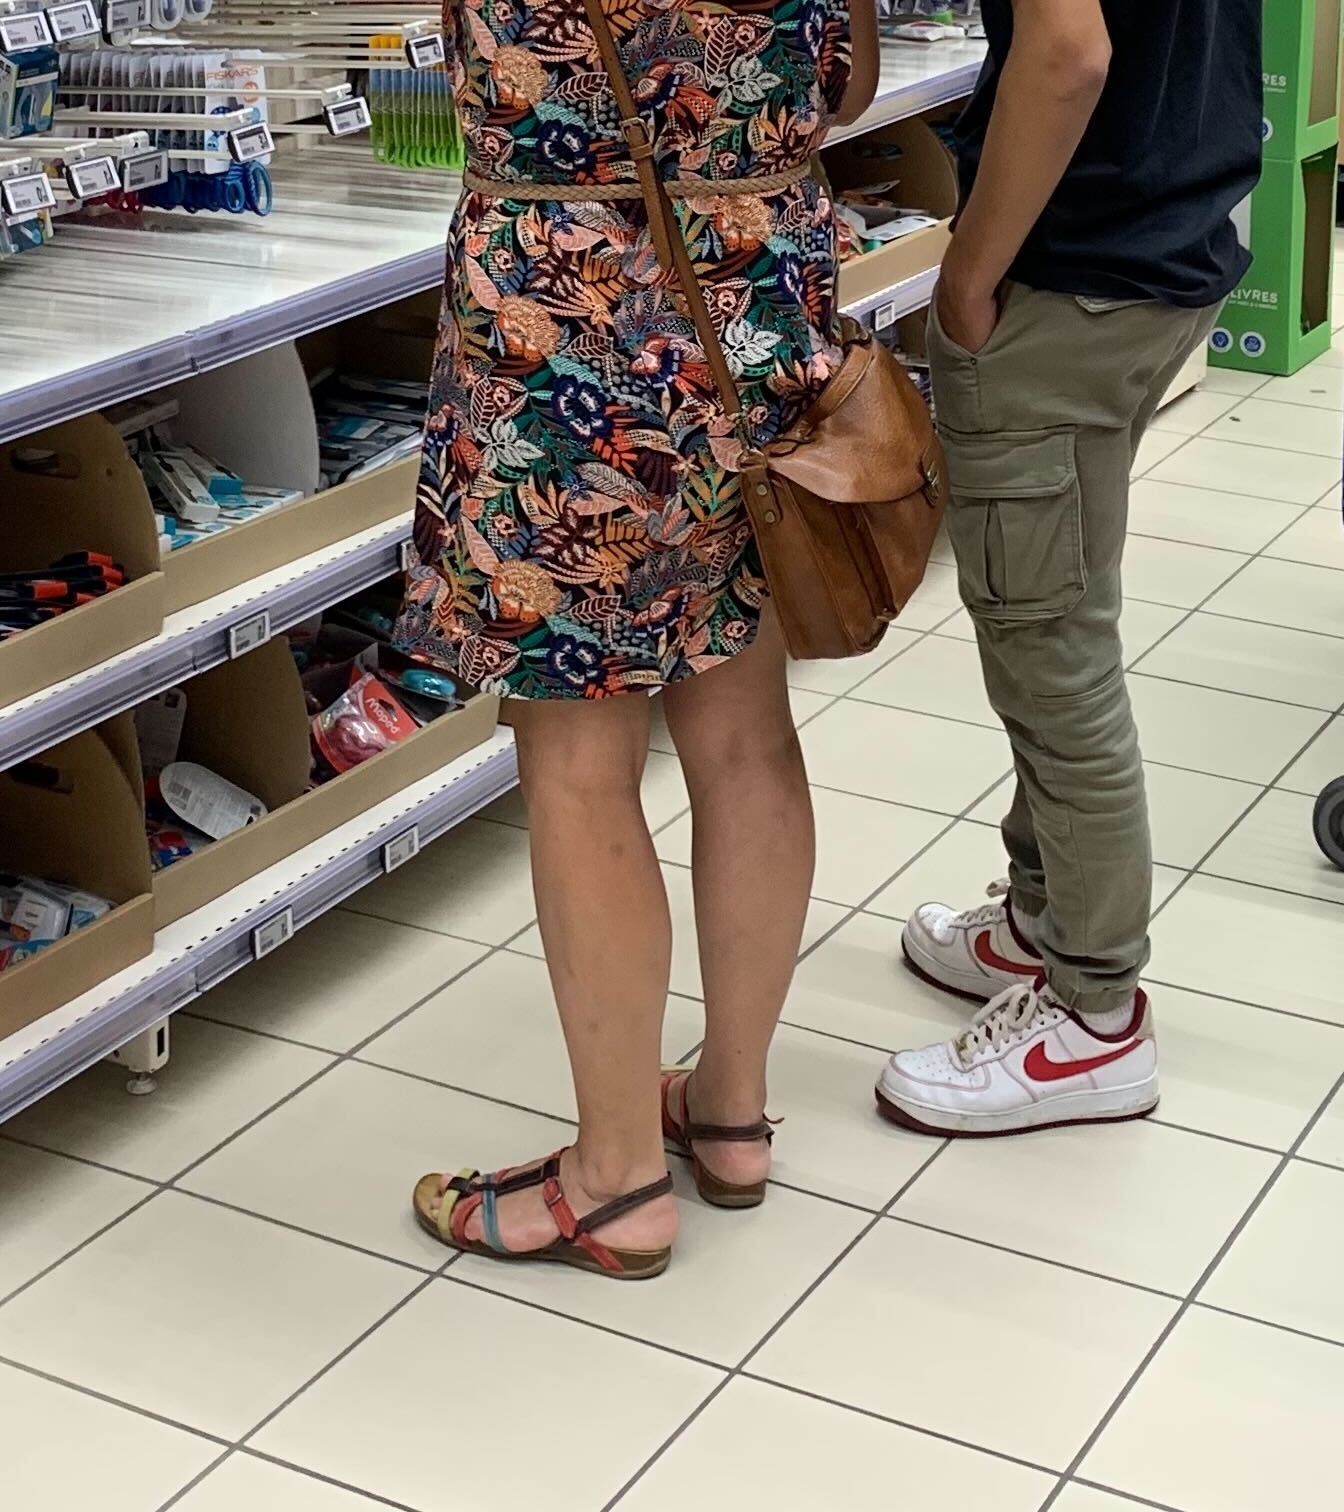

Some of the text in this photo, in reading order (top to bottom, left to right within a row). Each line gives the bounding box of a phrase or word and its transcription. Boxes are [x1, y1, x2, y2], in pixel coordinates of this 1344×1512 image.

[1262, 73, 1287, 86] RES
[1230, 288, 1278, 304] LIVRES
[365, 696, 400, 735] Maped
